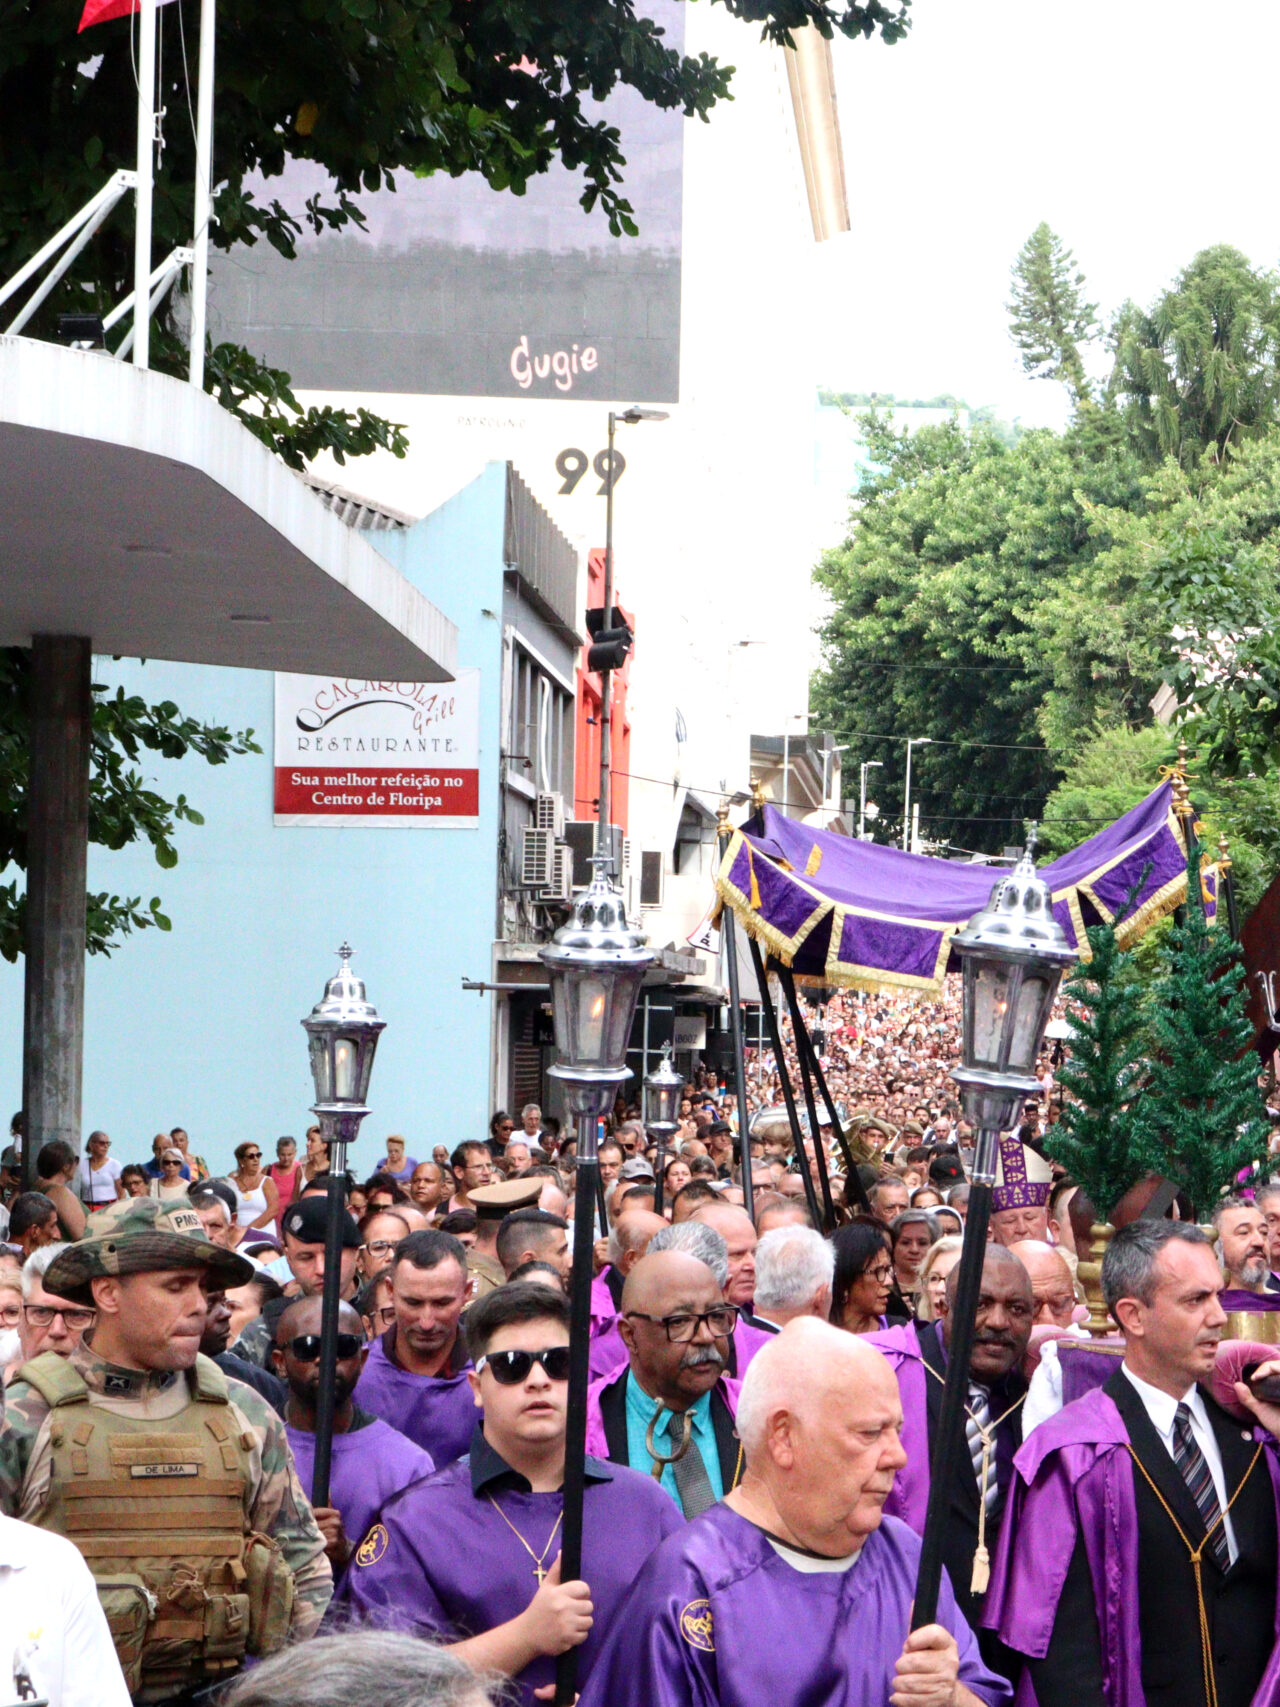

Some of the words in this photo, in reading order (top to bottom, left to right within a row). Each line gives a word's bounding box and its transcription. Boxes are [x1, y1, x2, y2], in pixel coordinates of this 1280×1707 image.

[510, 335, 599, 392] Gugie
[555, 447, 627, 496] 99
[412, 696, 456, 736] Grill
[297, 736, 454, 753] RESTAURANTE
[291, 772, 320, 786] Sua
[323, 772, 378, 787] melhor
[380, 773, 441, 790] refeição
[443, 776, 464, 787] no
[311, 791, 364, 806] Centro
[366, 792, 385, 806] de
[389, 792, 443, 810] Floripa
[145, 1466, 158, 1474] DE
[162, 1465, 185, 1473] LIMA
